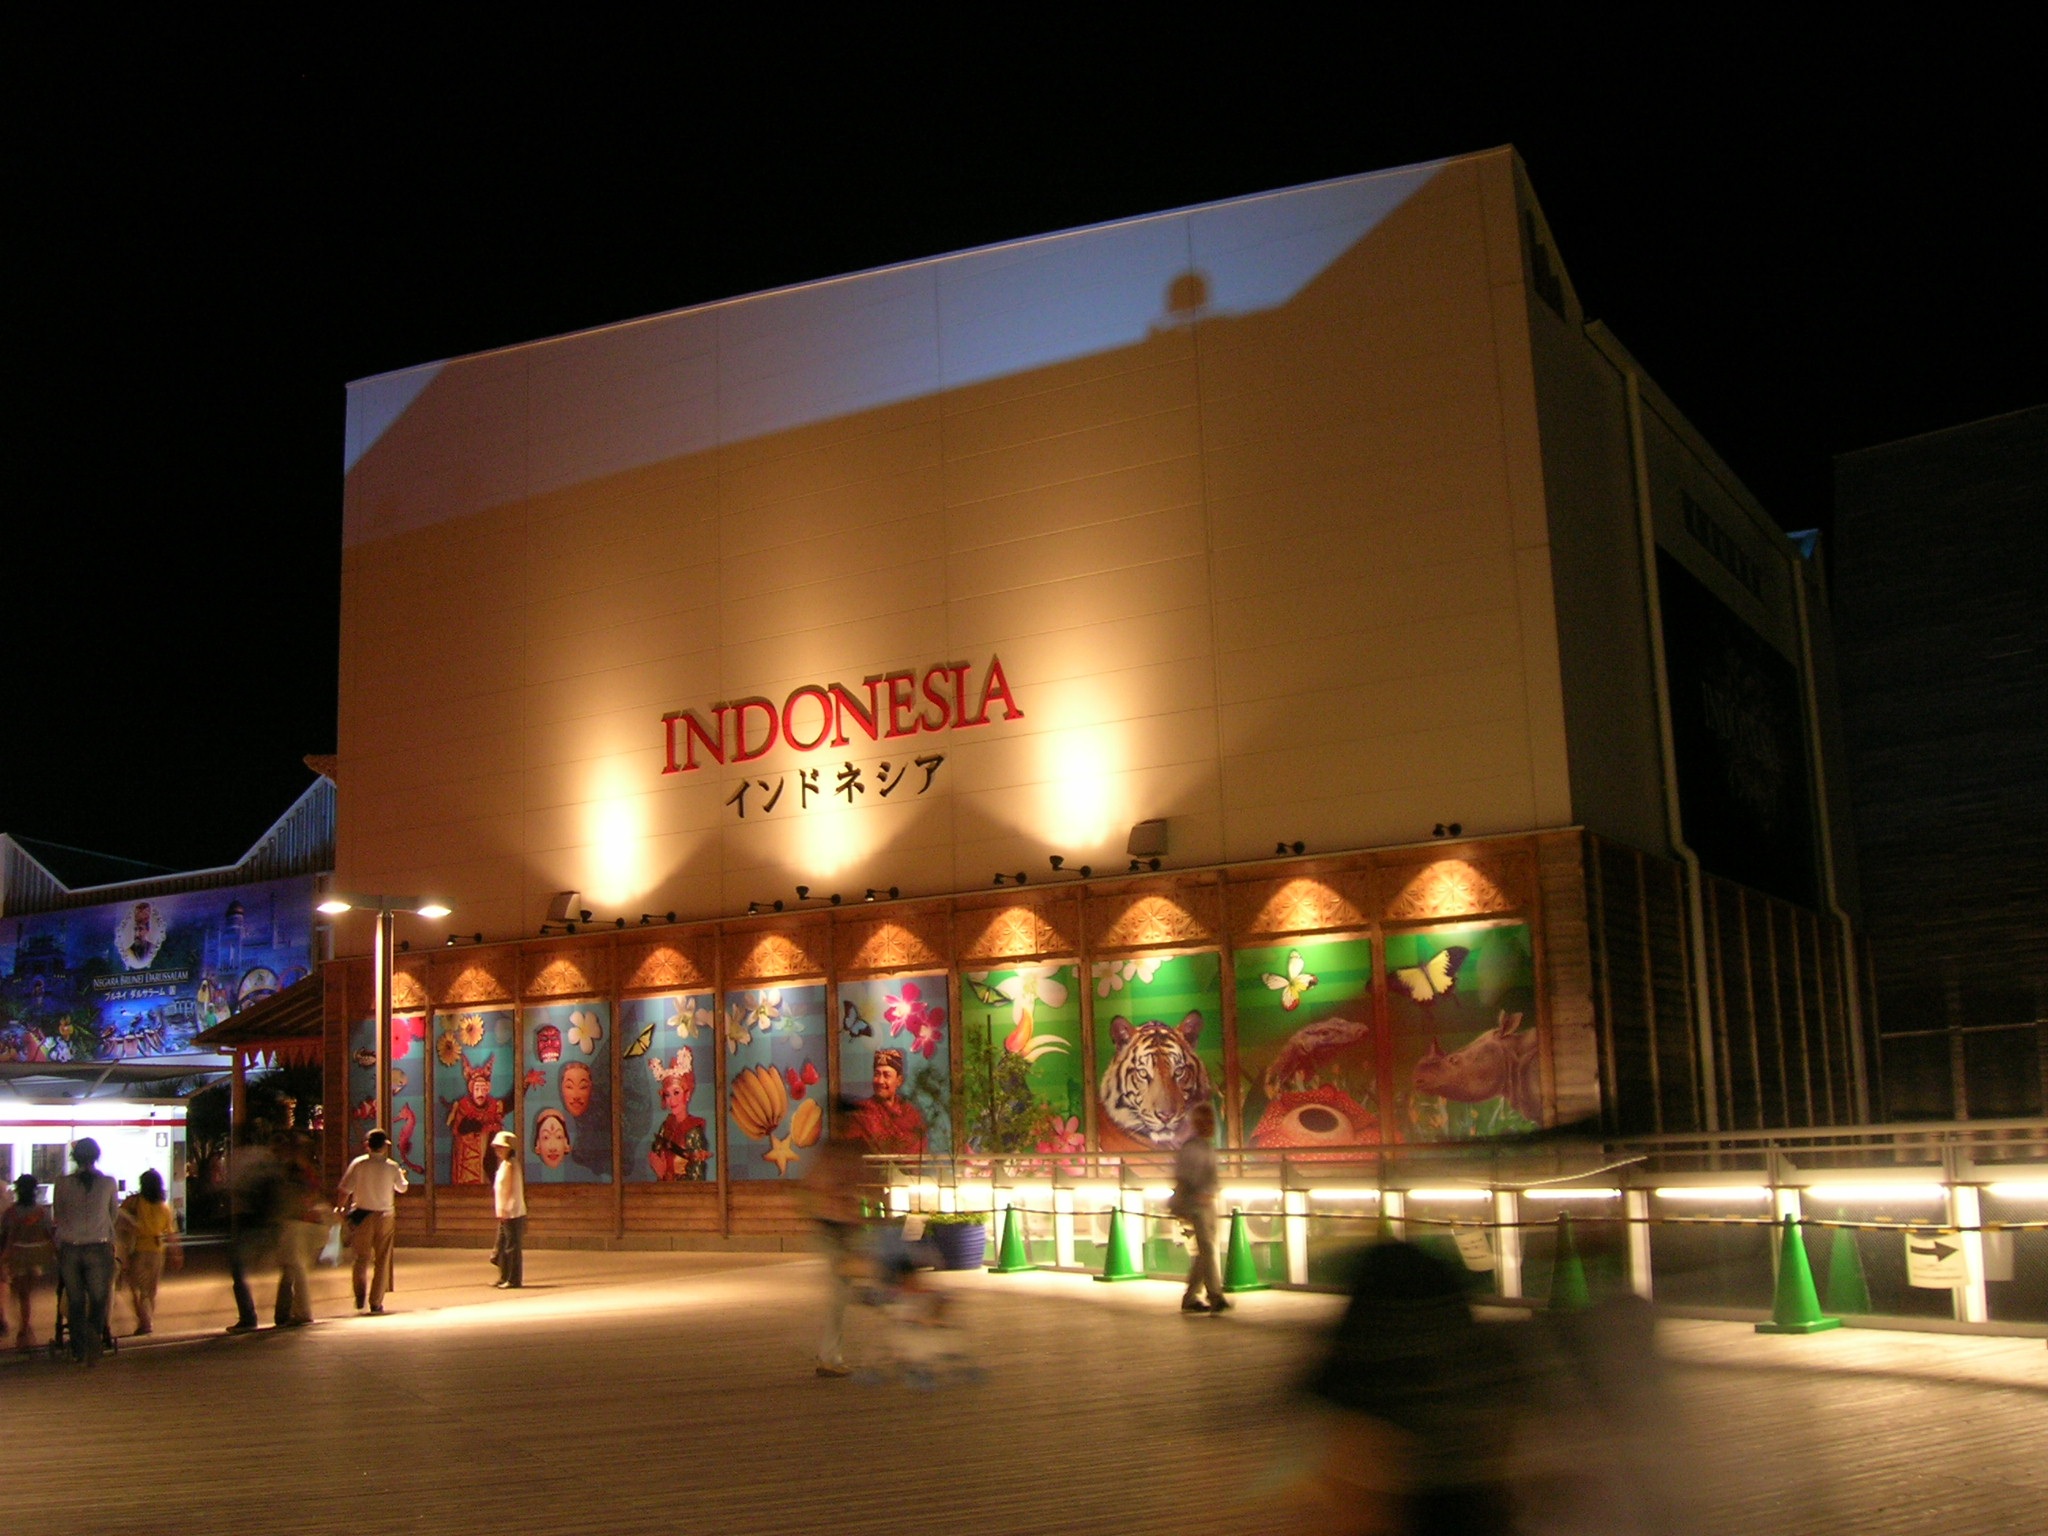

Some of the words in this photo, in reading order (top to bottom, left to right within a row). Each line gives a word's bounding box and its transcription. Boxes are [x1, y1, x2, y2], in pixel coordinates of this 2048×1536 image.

[661, 654, 1024, 774] INDONESIA
[726, 753, 946, 818] インドネシア
[93, 977, 118, 987] NEGARA
